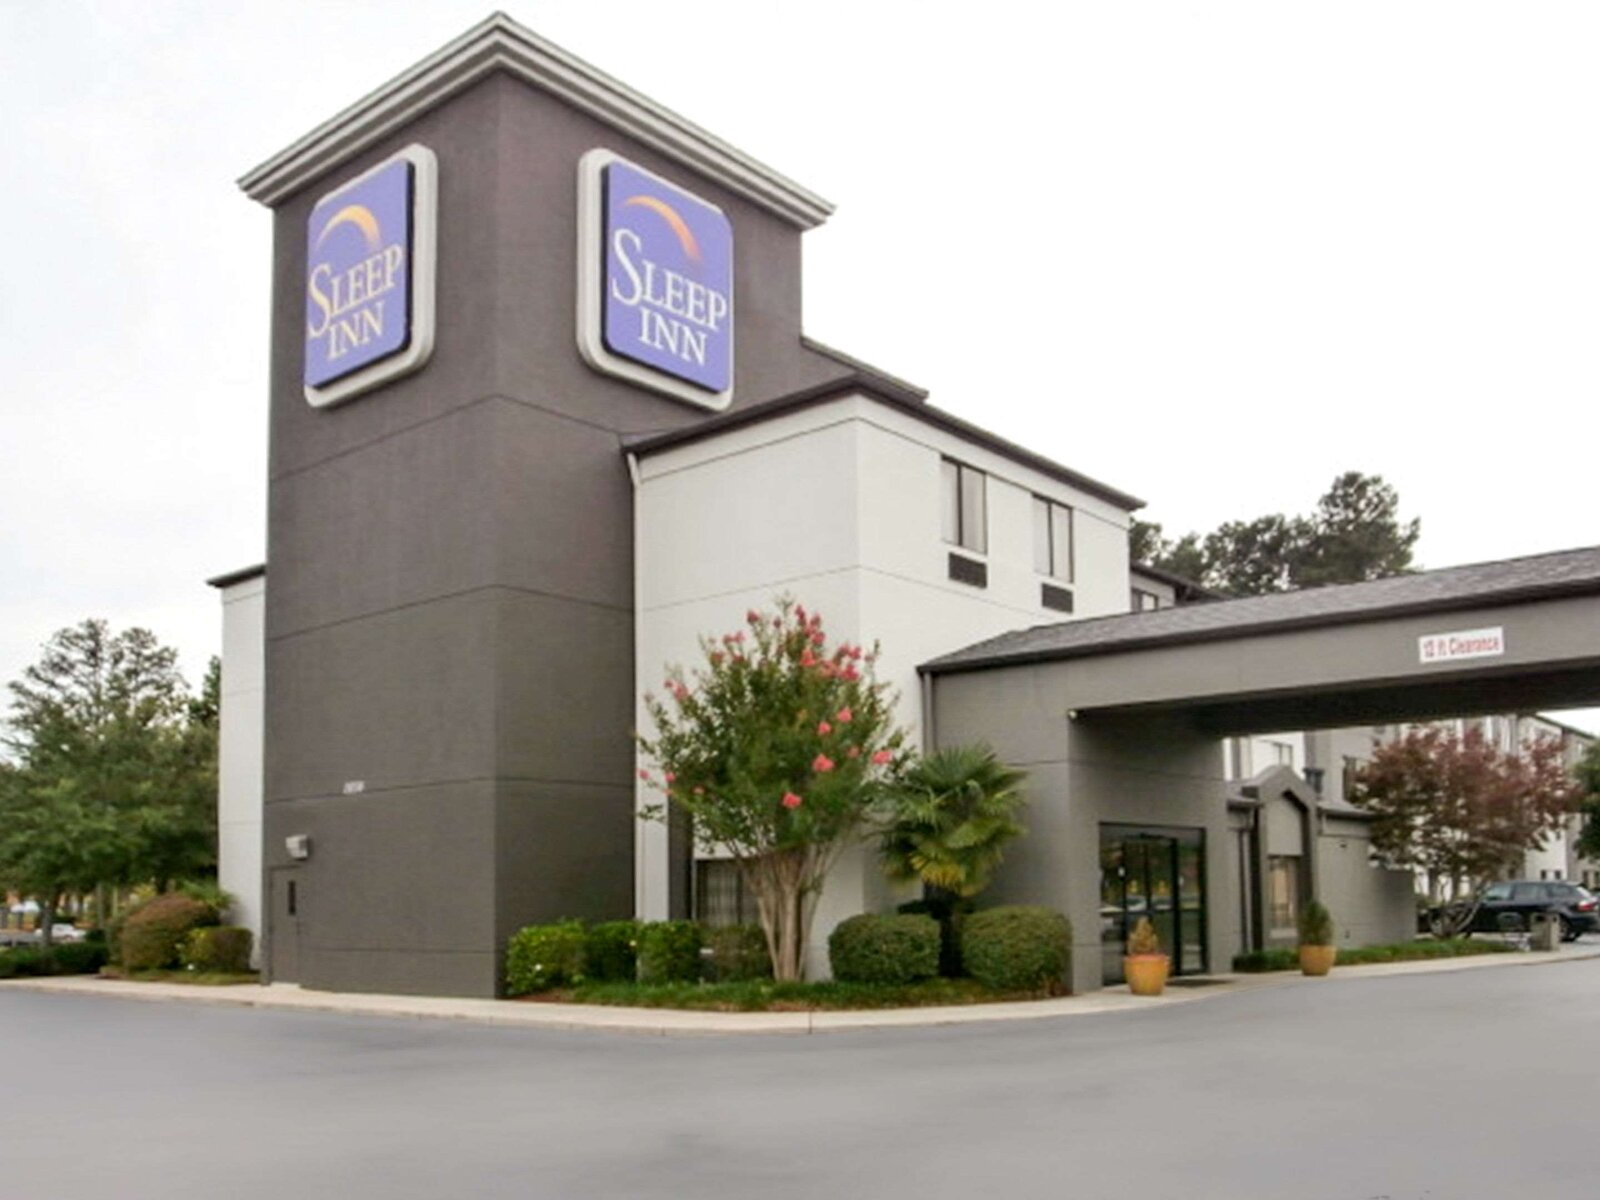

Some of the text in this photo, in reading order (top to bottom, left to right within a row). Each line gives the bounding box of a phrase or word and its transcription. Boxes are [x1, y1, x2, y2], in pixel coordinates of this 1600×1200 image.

[307, 244, 402, 338] SLEEP
[611, 228, 727, 332] SLEEP
[328, 300, 384, 359] INN
[638, 305, 707, 365] INN
[1449, 637, 1499, 655] Clearance
